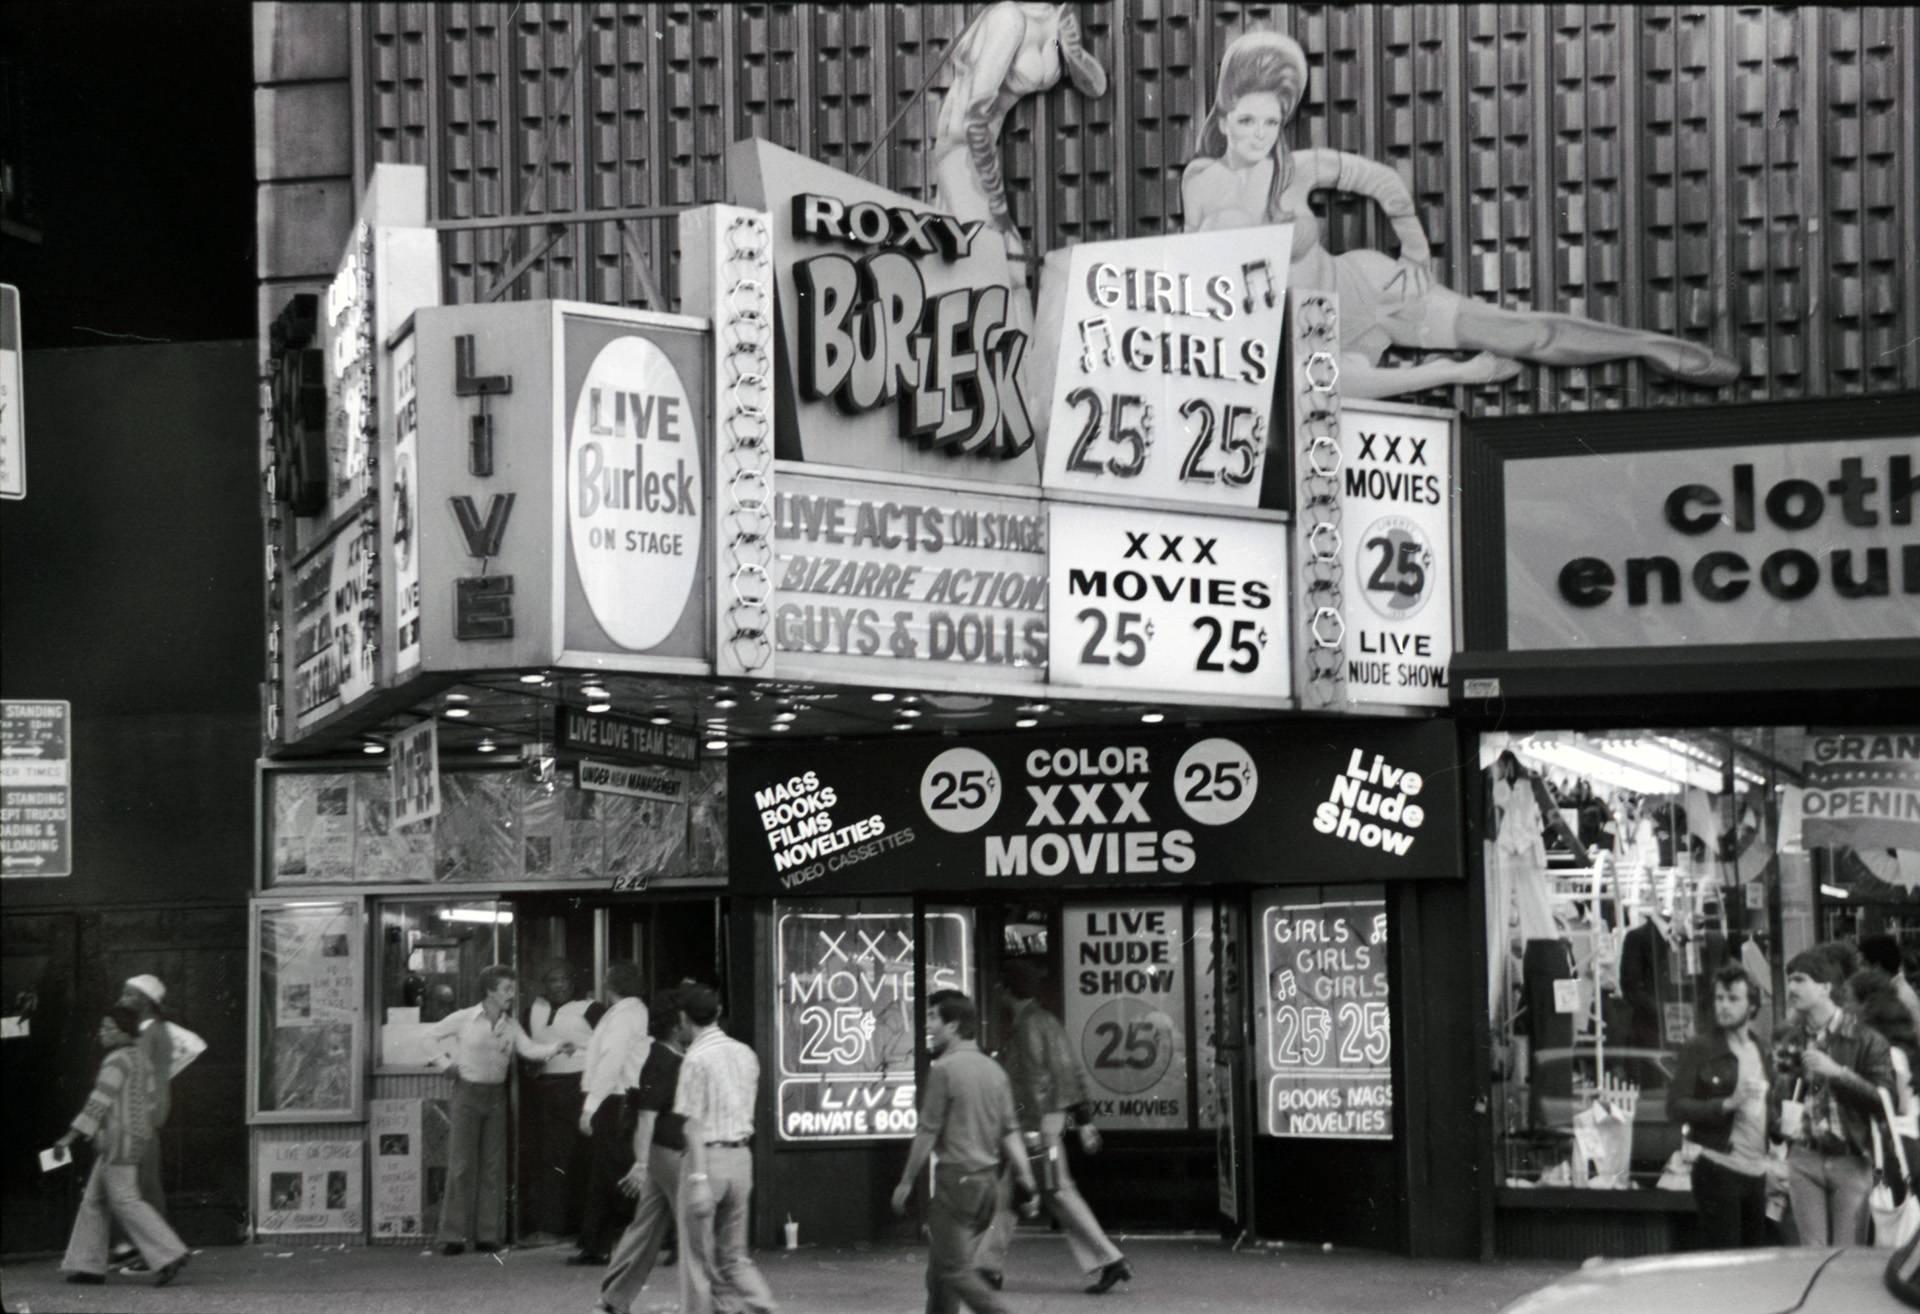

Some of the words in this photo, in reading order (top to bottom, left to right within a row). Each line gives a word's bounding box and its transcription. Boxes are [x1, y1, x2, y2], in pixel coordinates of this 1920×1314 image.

[798, 194, 985, 257] ROXY
[1087, 262, 1236, 321] GIRLS
[798, 252, 1035, 457] BURLESK
[1122, 327, 1270, 385] GIRLS
[588, 387, 681, 443] LIVE
[1359, 431, 1428, 467] XXX
[448, 332, 517, 641] LIVE
[577, 442, 697, 518] Burlesk
[1345, 469, 1442, 505] MOVIES
[774, 491, 847, 542] LIVE
[853, 505, 945, 553] ACTS
[951, 511, 979, 545] ON
[981, 512, 1044, 553] STAGE
[589, 527, 616, 551] ON
[625, 530, 684, 557] STAGE
[1123, 531, 1218, 566] XXX
[780, 556, 923, 600] BIZARRE
[925, 568, 1049, 611] ACTION
[1068, 568, 1272, 610] MOVIES
[774, 602, 881, 655] GUYS
[889, 611, 919, 660] &
[928, 613, 1048, 667] DOLLS
[1360, 631, 1431, 658] LIVE
[1348, 661, 1391, 686] NUDE
[1397, 662, 1449, 690] SHOW
[5, 704, 64, 719] STANDING
[569, 715, 597, 744] LIVE
[600, 718, 629, 749] LOVE
[631, 726, 665, 755] TEAM
[666, 732, 698, 761] SHOW
[26, 766, 62, 777] TIMES
[582, 766, 610, 785] UNDER
[1026, 746, 1151, 779] COLOR
[1346, 747, 1424, 796] Live
[7, 792, 65, 806] STANDING
[754, 771, 820, 811] MAGS
[760, 786, 838, 831] BOOKS
[1025, 781, 1152, 827] XXX
[1328, 773, 1425, 829] Nude
[24, 807, 67, 821] TRUCKS
[47, 823, 57, 837] &
[767, 811, 833, 852] FILMS
[1312, 800, 1416, 857] Show
[773, 814, 886, 873] NOVELTIES
[780, 861, 826, 889] VIDEO
[827, 827, 916, 872] CASSETTES
[985, 829, 1197, 877] MOVIES
[1087, 910, 1166, 937] LIVE
[1274, 918, 1350, 944] GIRLS
[1079, 940, 1169, 966] NUDE
[1296, 946, 1371, 974] GIRLS
[1079, 969, 1175, 996] SHOW
[1314, 973, 1390, 1001] GIRLS
[821, 1084, 917, 1110] LIVE
[1119, 1100, 1179, 1117] MOVIES
[1278, 1087, 1342, 1112] BOOKS
[787, 1111, 868, 1134] PRIVATE
[1289, 1110, 1386, 1134] NOVELTIES
